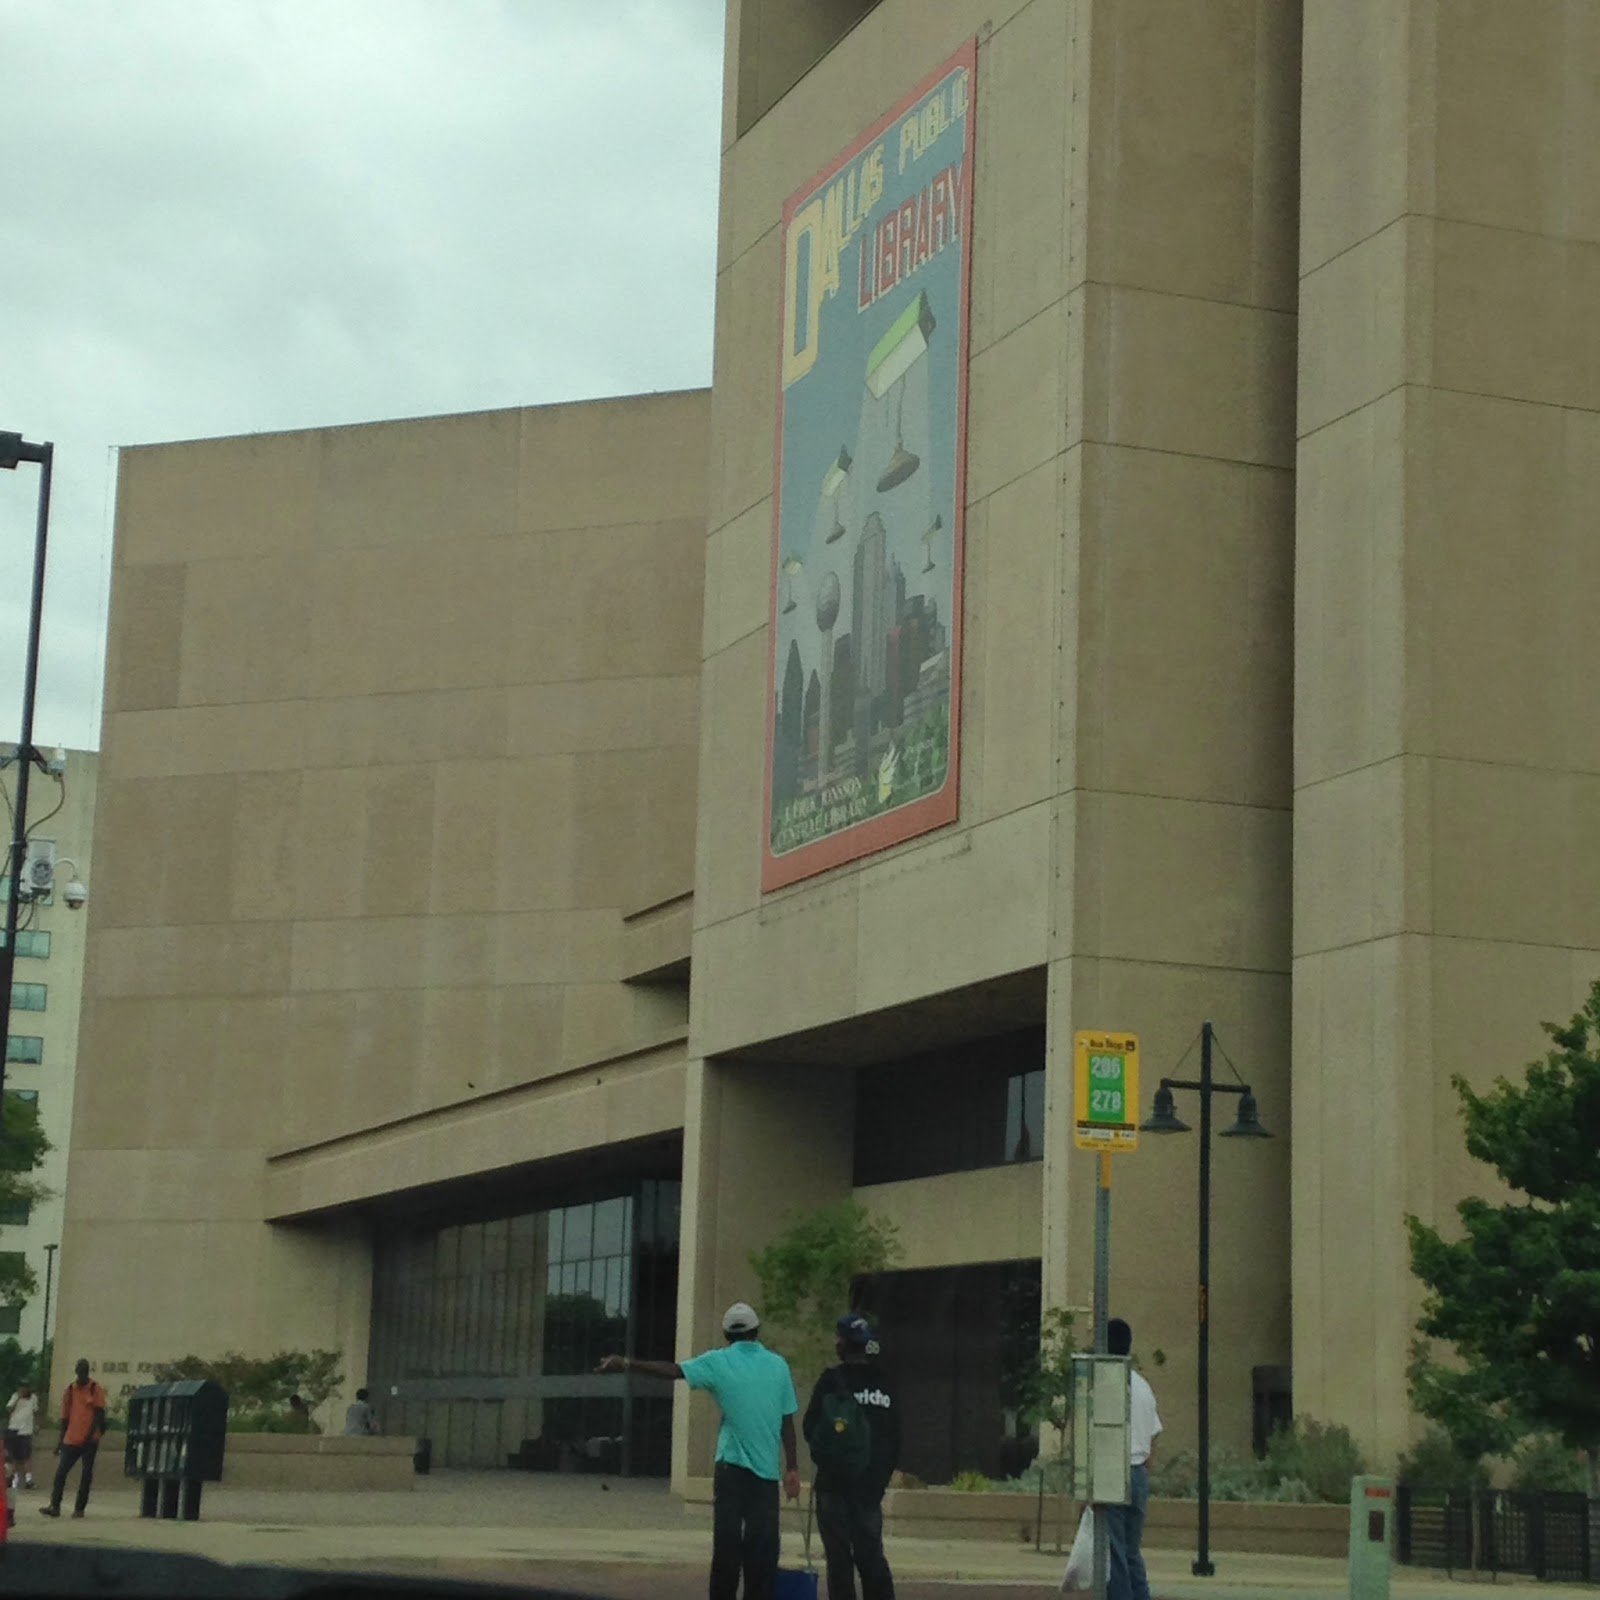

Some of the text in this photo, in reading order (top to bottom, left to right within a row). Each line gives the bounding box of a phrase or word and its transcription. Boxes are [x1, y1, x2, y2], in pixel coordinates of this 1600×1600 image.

[782, 69, 970, 391] DALLAS PUBLIC
[857, 159, 964, 314] LIBRARY
